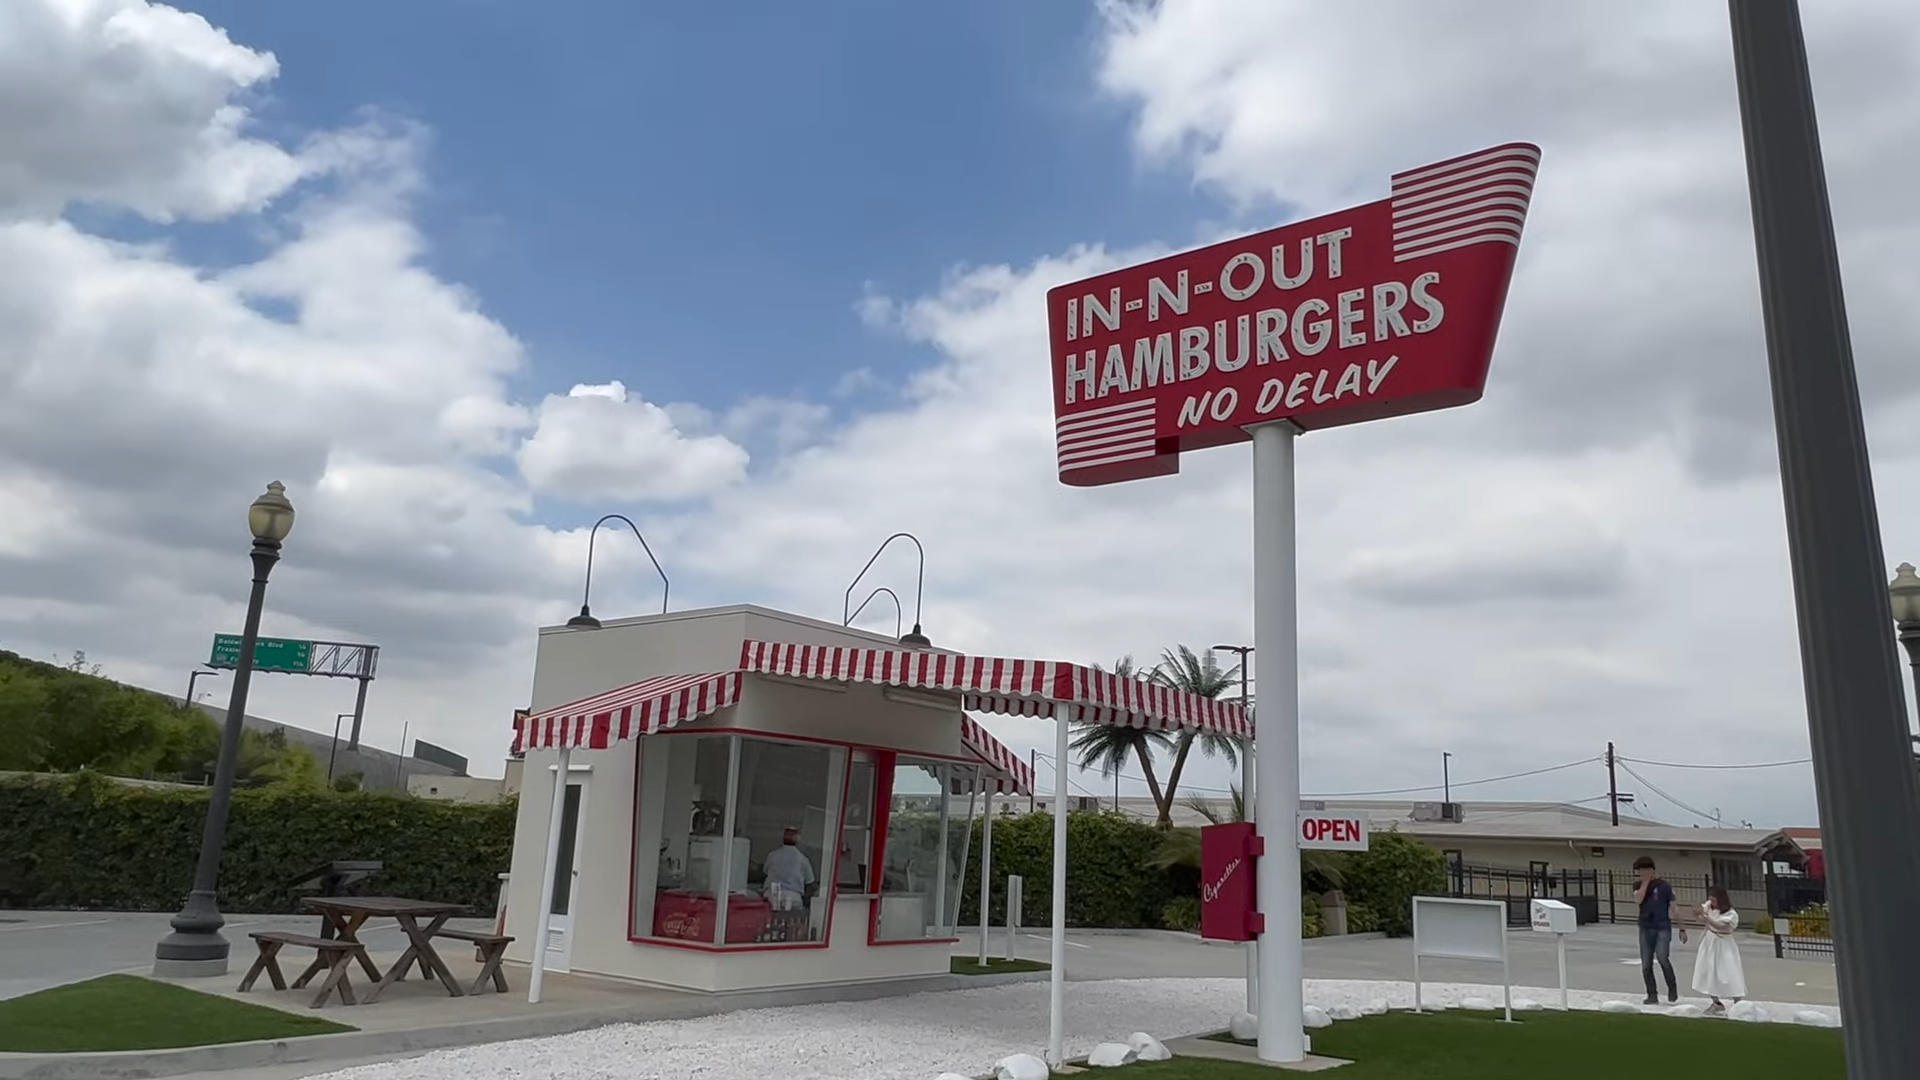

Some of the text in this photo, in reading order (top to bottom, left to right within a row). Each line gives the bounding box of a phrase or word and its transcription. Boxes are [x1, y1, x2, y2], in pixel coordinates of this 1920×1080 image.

[1066, 227, 1352, 342] IN-N-OUT
[1065, 272, 1445, 405] HAMBURGERS
[1177, 354, 1399, 429] NO DELAY
[1302, 818, 1361, 842] OPEN
[1203, 858, 1241, 902] Cigarettes
